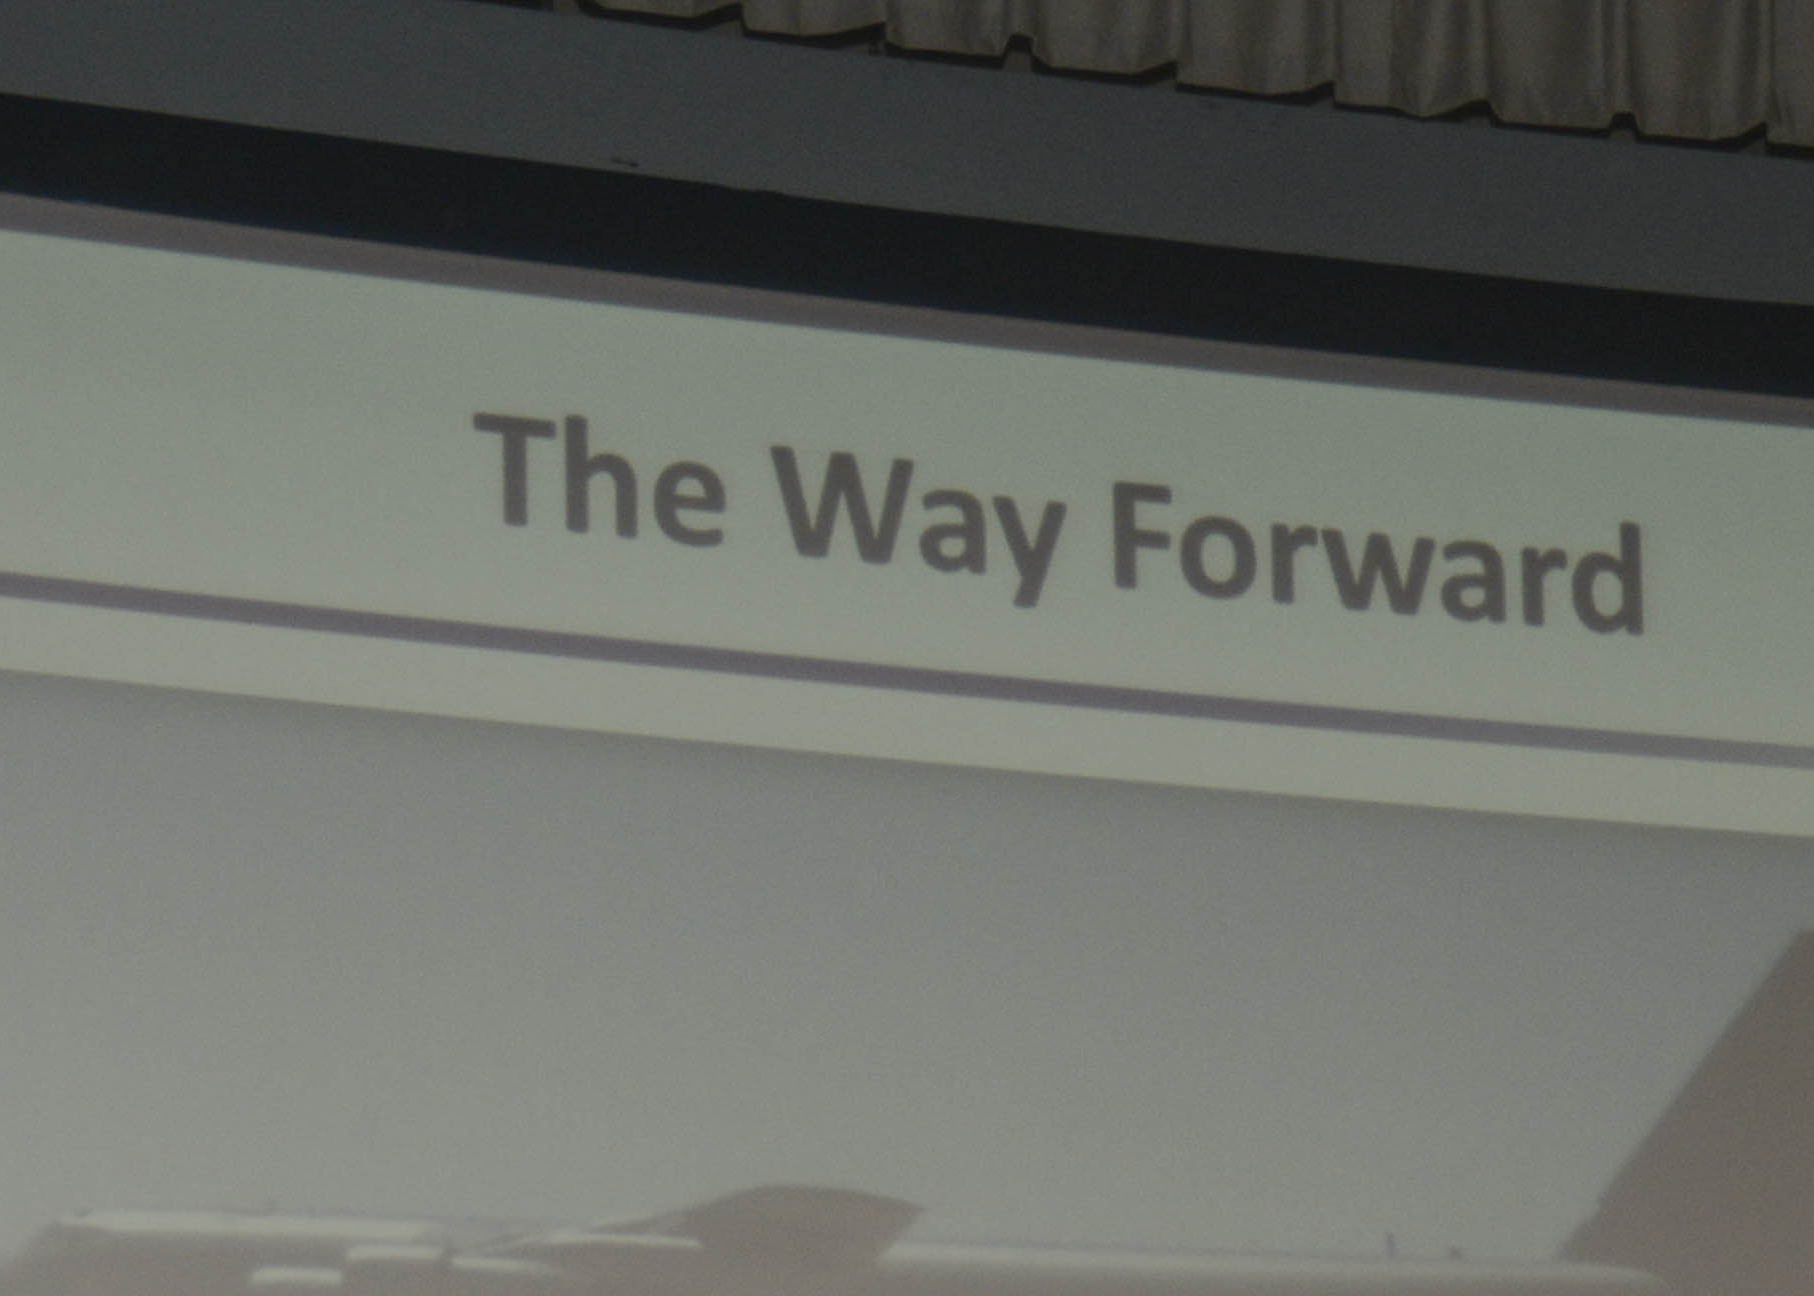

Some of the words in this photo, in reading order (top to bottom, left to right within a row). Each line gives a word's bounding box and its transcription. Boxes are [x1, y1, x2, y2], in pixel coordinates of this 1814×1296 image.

[472, 411, 728, 548] The
[770, 444, 1068, 610] Way
[1112, 481, 1647, 637] Forward
